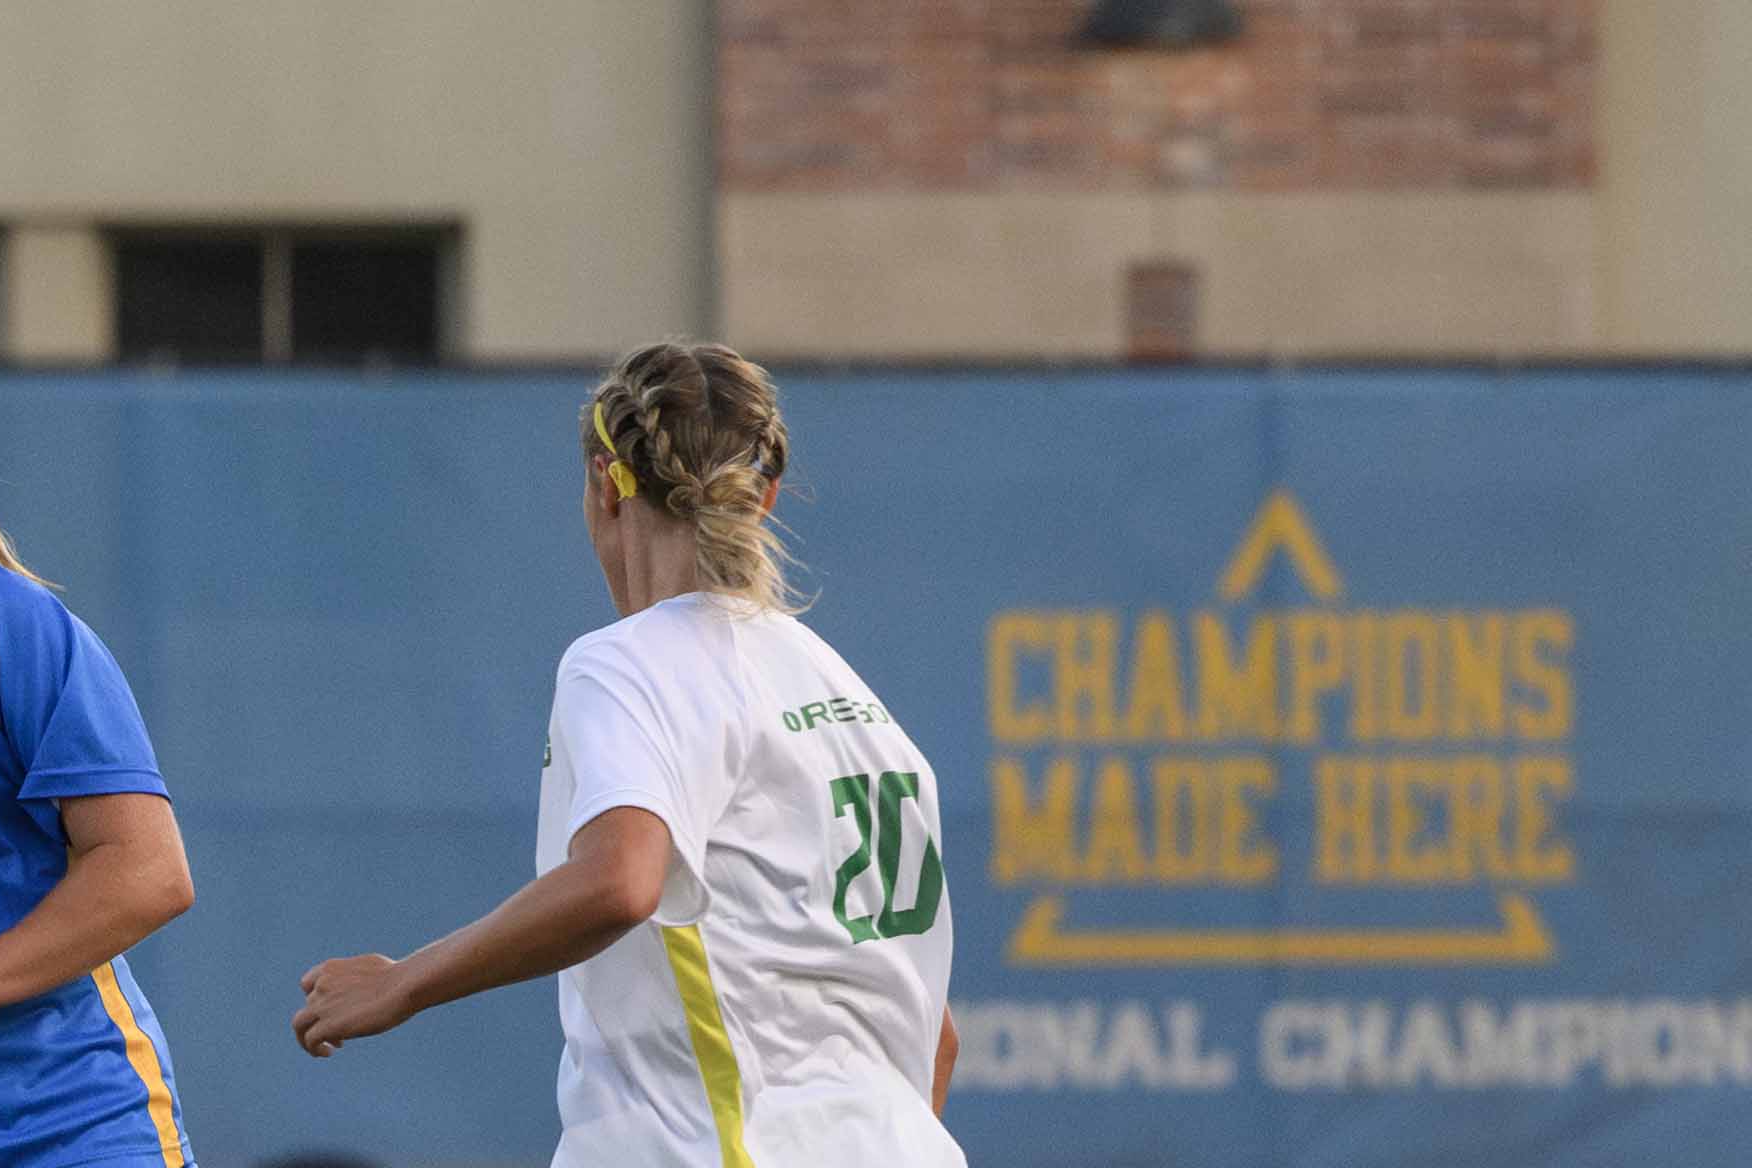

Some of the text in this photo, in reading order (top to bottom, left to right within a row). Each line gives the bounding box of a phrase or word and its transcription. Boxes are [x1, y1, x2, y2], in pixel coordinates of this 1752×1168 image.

[989, 612, 1575, 742] CHAMPIONS
[830, 771, 943, 944] 20
[991, 756, 1574, 884] MADE HERE
